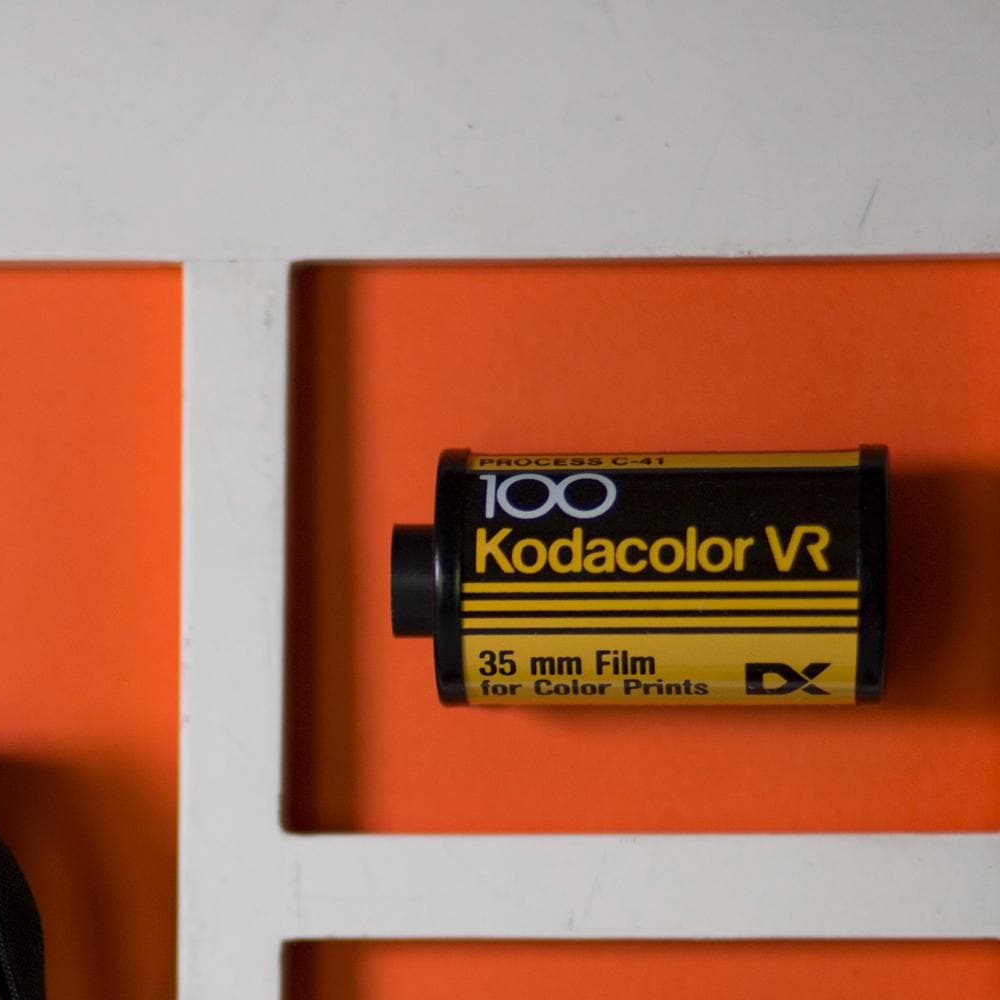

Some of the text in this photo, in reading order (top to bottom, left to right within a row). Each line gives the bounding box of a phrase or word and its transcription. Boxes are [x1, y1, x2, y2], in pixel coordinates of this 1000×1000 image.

[480, 457, 665, 467] PROCESS C-41
[479, 472, 617, 520] 100
[475, 525, 831, 575] Kodacolor VR
[478, 650, 656, 677] 35 mm Film
[480, 678, 709, 696] for Color Prints
[745, 662, 831, 696] DX
